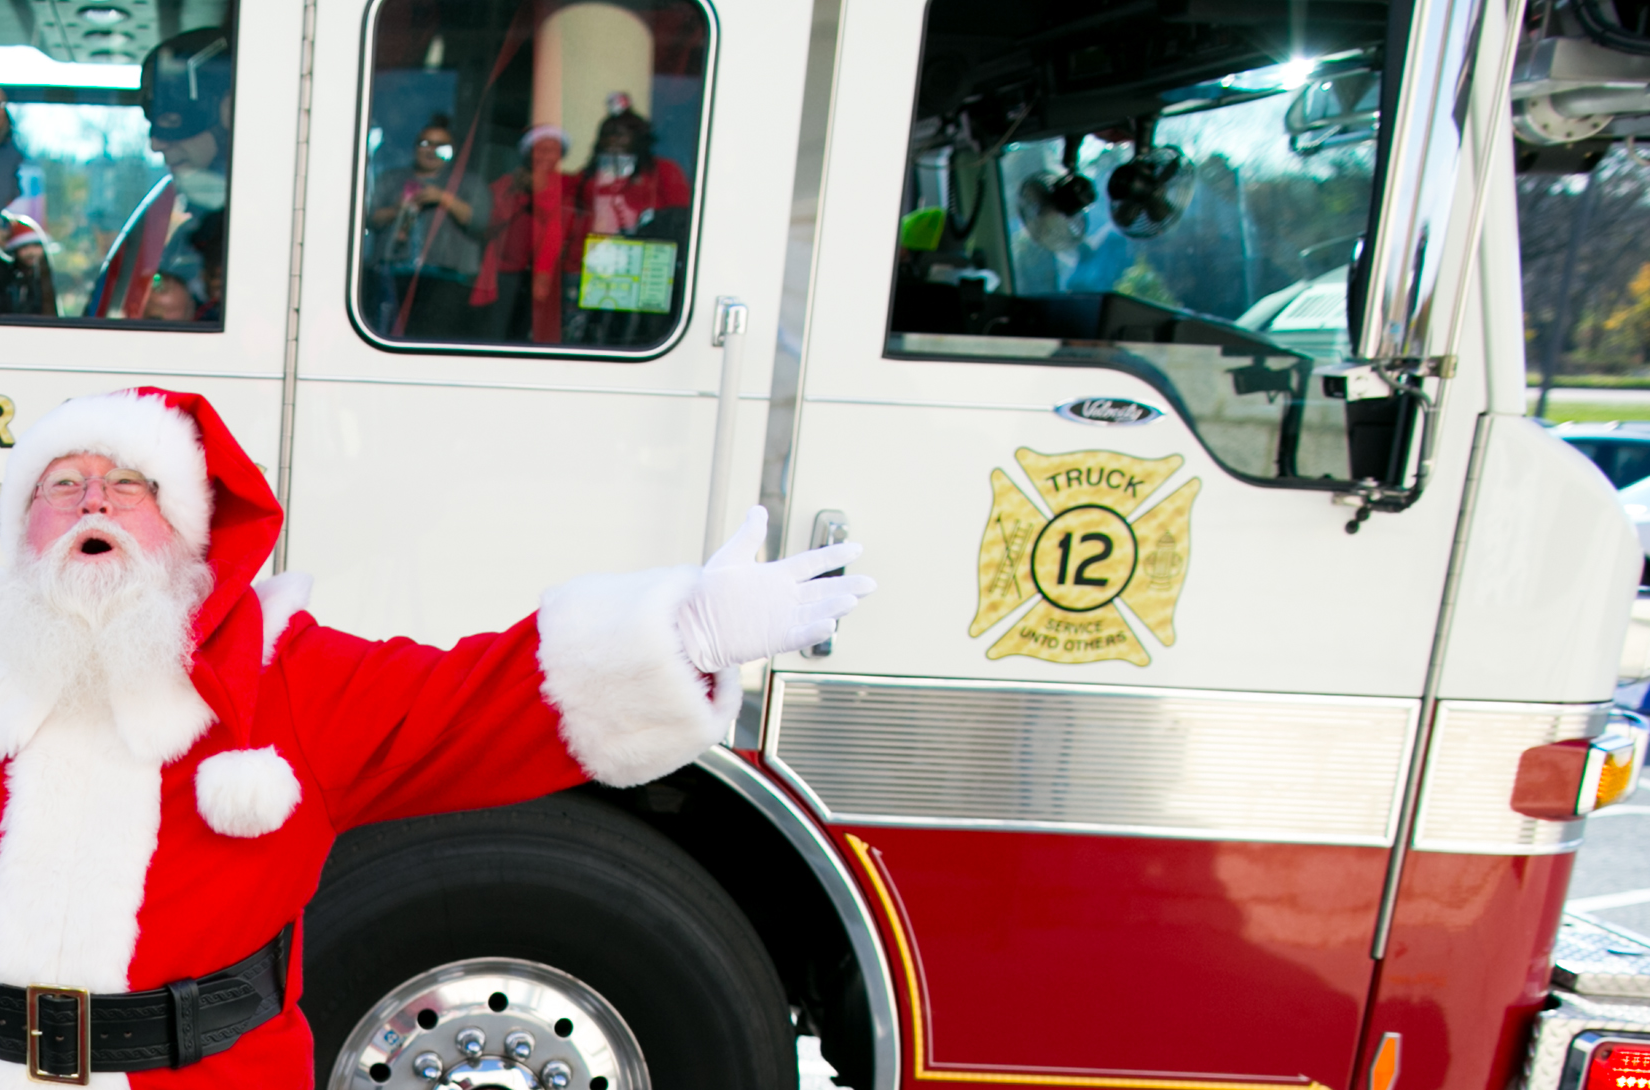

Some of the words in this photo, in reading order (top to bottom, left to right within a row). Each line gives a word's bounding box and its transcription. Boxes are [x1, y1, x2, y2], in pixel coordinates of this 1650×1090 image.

[1044, 467, 1145, 498] TRUCK
[1057, 532, 1114, 586] 12
[1020, 626, 1059, 649] UNTO
[1064, 630, 1126, 652] OTHERS
[1047, 618, 1104, 634] SERVICE
